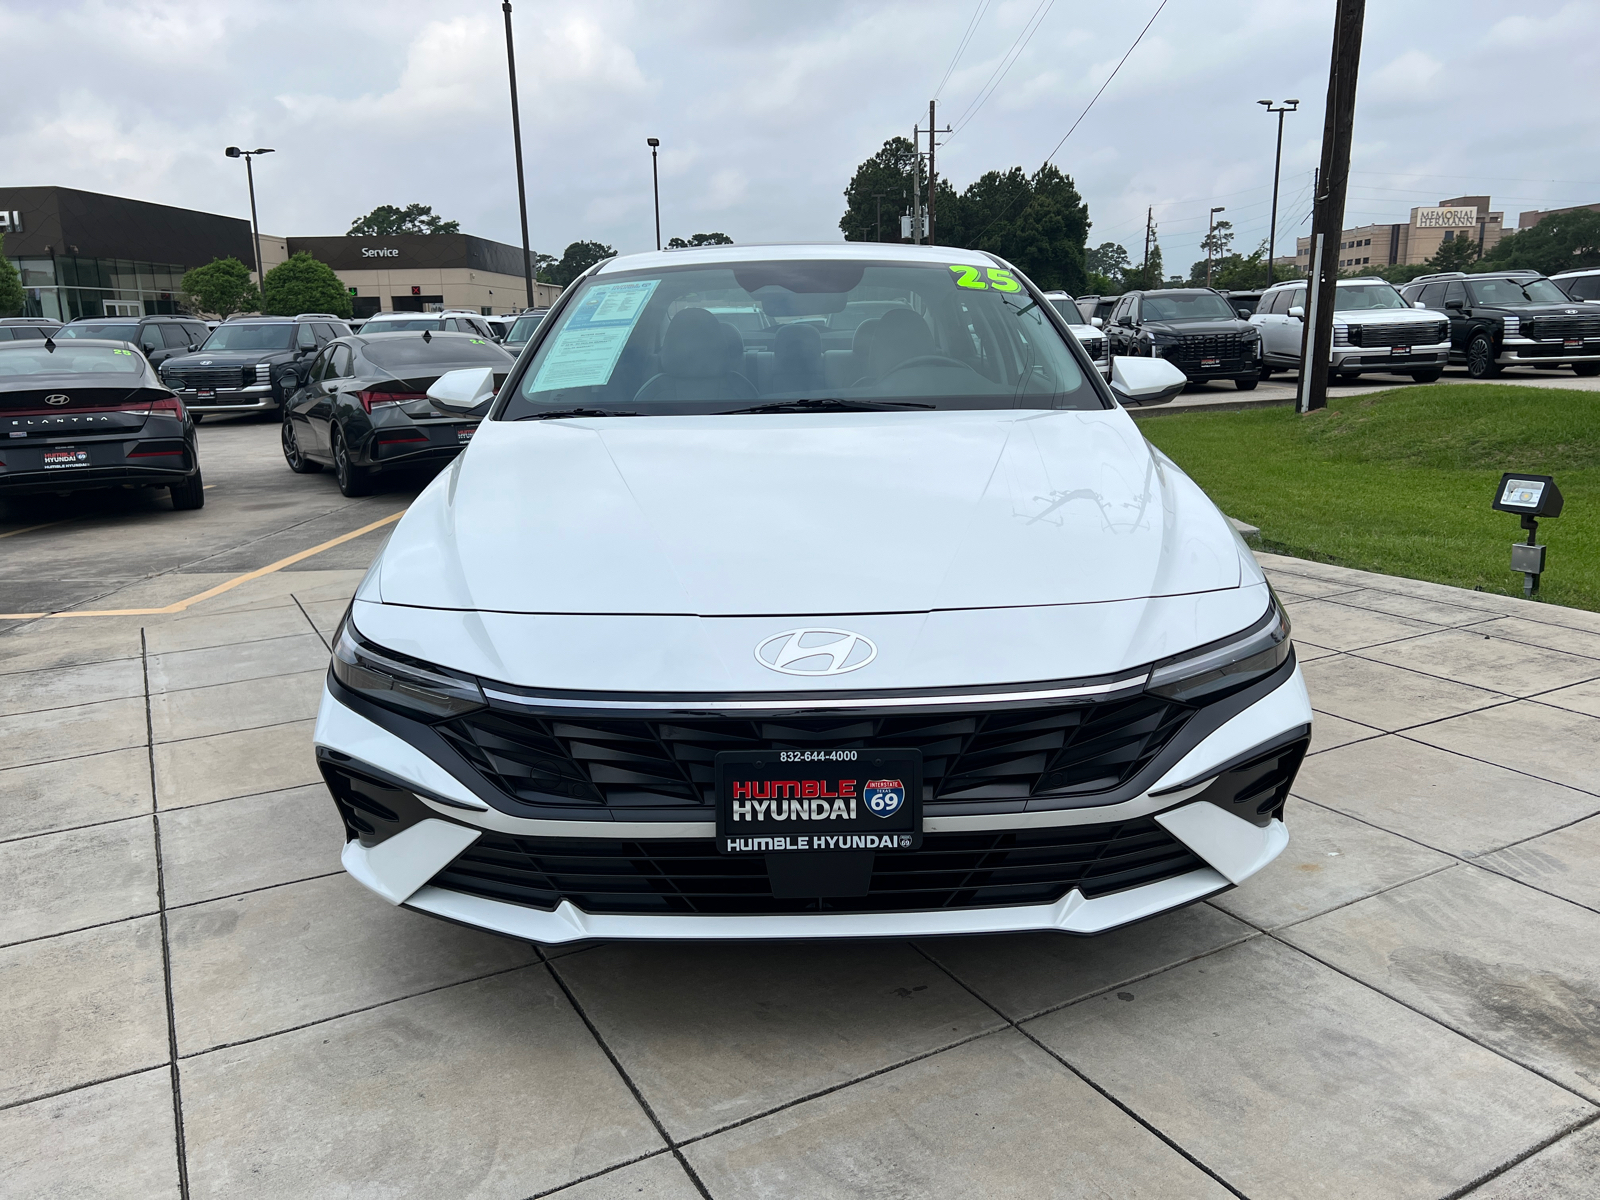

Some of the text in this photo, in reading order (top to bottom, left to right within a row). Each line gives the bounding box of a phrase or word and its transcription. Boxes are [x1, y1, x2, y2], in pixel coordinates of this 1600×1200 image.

[1420, 210, 1474, 219] MEMORIAL
[1420, 217, 1473, 226] HERMANN
[361, 247, 399, 257] Service
[948, 265, 1021, 293] 25
[12, 416, 108, 425] ELANTRA
[780, 750, 858, 762] 832-644-4000
[733, 779, 857, 799] HUMBLE
[870, 793, 899, 811] 69
[733, 799, 857, 821] HYUNDAI
[727, 837, 809, 851] HUMBLE
[813, 835, 898, 849] HYUNDAI
